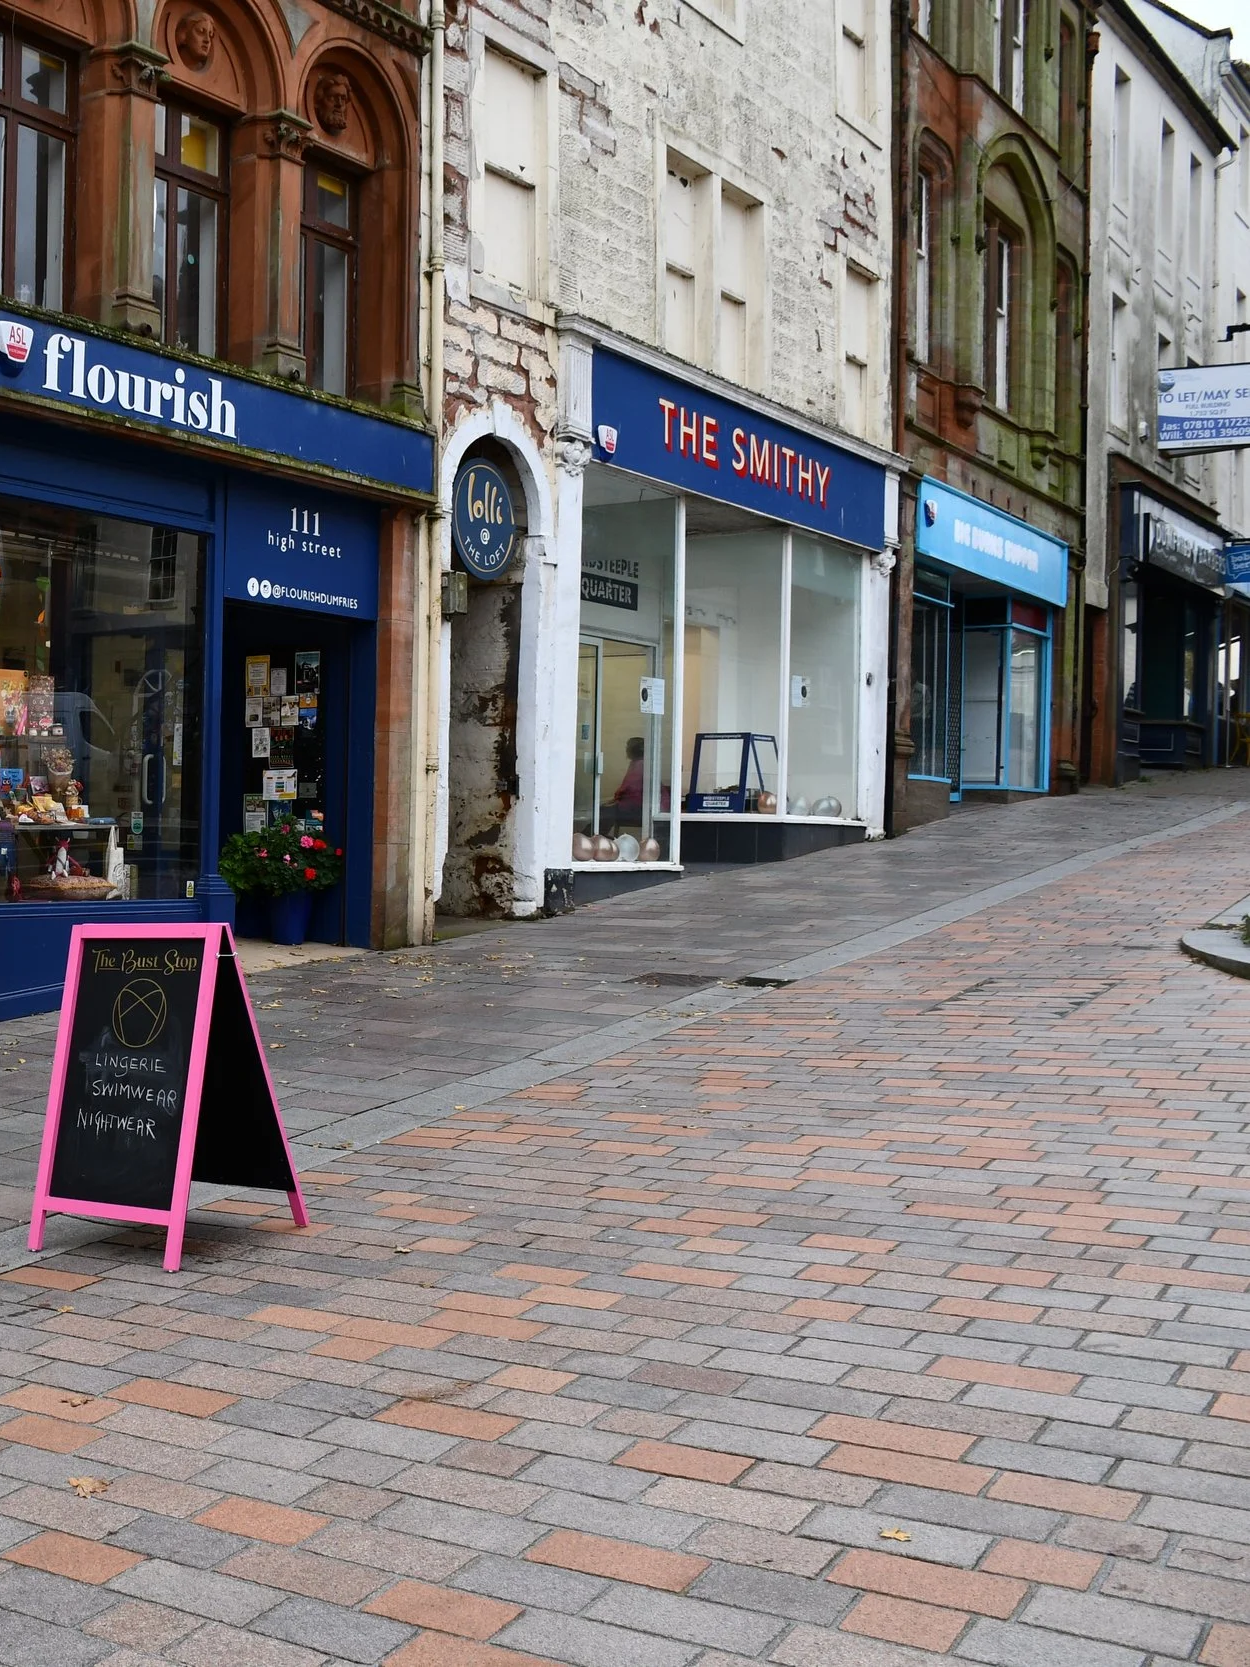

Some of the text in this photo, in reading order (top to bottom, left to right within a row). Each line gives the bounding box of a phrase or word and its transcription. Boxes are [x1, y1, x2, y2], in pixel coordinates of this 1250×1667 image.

[9, 325, 26, 346] ASL
[41, 333, 237, 439] flourish
[1158, 393, 1174, 404] TO
[1159, 431, 1183, 440] Will:
[1185, 430, 1217, 439] 07581
[1161, 418, 1250, 432] Jas: 07810 71722
[658, 397, 832, 510] THE SMITHY
[467, 471, 503, 525] lolli
[290, 507, 321, 537] 111
[268, 530, 342, 559] high street
[480, 527, 491, 545] @
[464, 535, 506, 566] THE LOFT
[272, 583, 358, 609] @FLOURISHDUMFRIES
[581, 577, 632, 604] QUARTER
[92, 949, 198, 976] The Bust Stop
[95, 1053, 167, 1078] LINGERIE
[92, 1079, 178, 1114] SWIMWEAR
[76, 1108, 156, 1140] NIGHTWEAR
